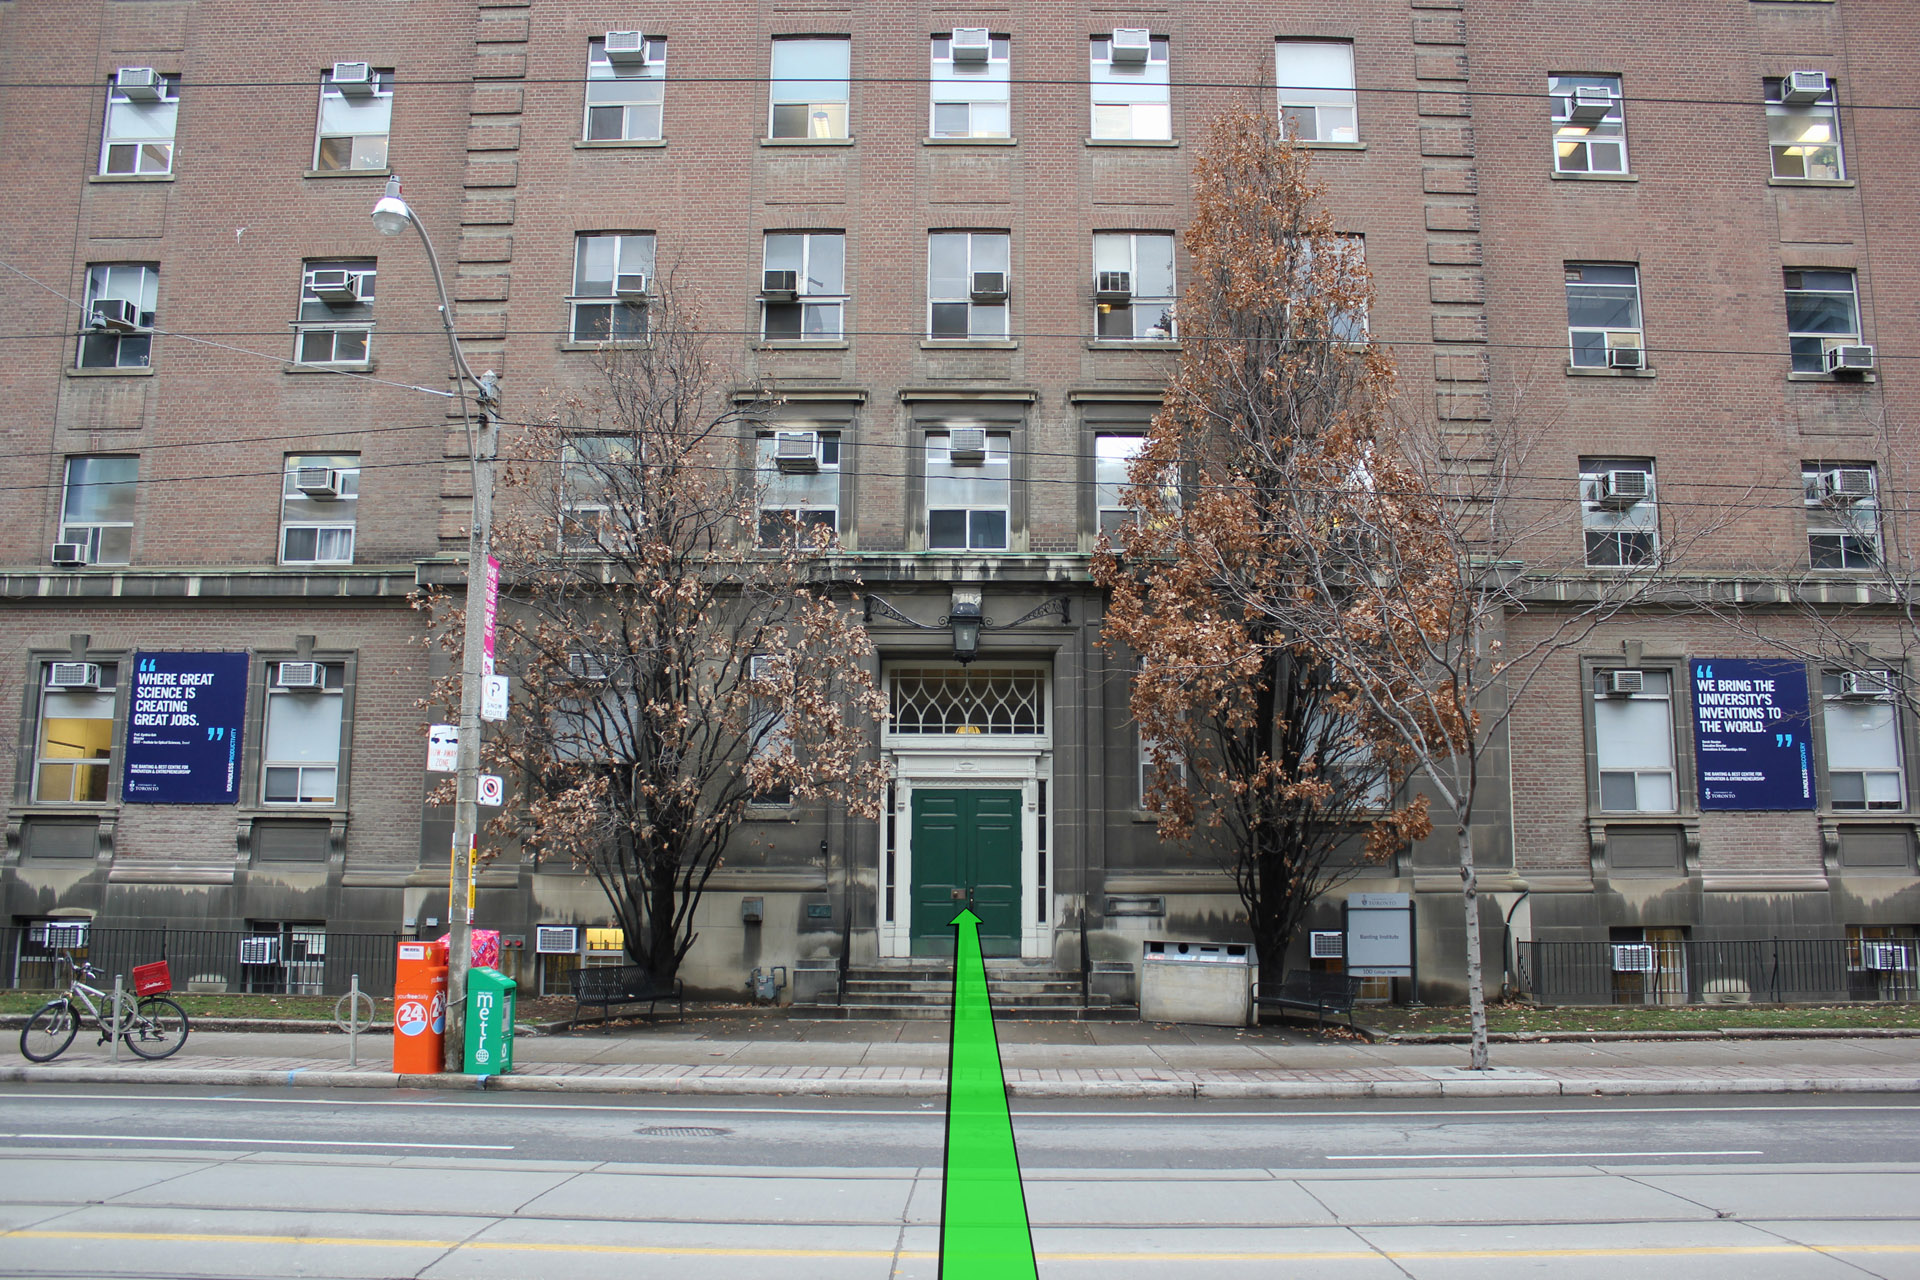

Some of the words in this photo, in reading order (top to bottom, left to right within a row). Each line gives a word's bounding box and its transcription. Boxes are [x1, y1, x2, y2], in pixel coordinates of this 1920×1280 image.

[138, 673, 177, 685] WHERE
[179, 673, 214, 686] GREAT
[1697, 679, 1716, 692] WE
[1718, 679, 1751, 692] BRING
[1753, 679, 1776, 692] THE
[136, 686, 182, 699] SCIENCE
[185, 687, 196, 699] IS
[1698, 693, 1773, 706] UNIVERSITY'S
[135, 700, 188, 713] CREATING
[1699, 707, 1765, 719] INVENTIONS
[1766, 707, 1782, 719] TO
[134, 713, 169, 726] GREAT
[169, 714, 200, 726] JOBS.
[1699, 720, 1722, 733] THE
[1724, 720, 1767, 733] WORLD.
[435, 758, 449, 766] ZONE
[396, 993, 429, 1001] yourfreedaily
[400, 1004, 424, 1022] 24
